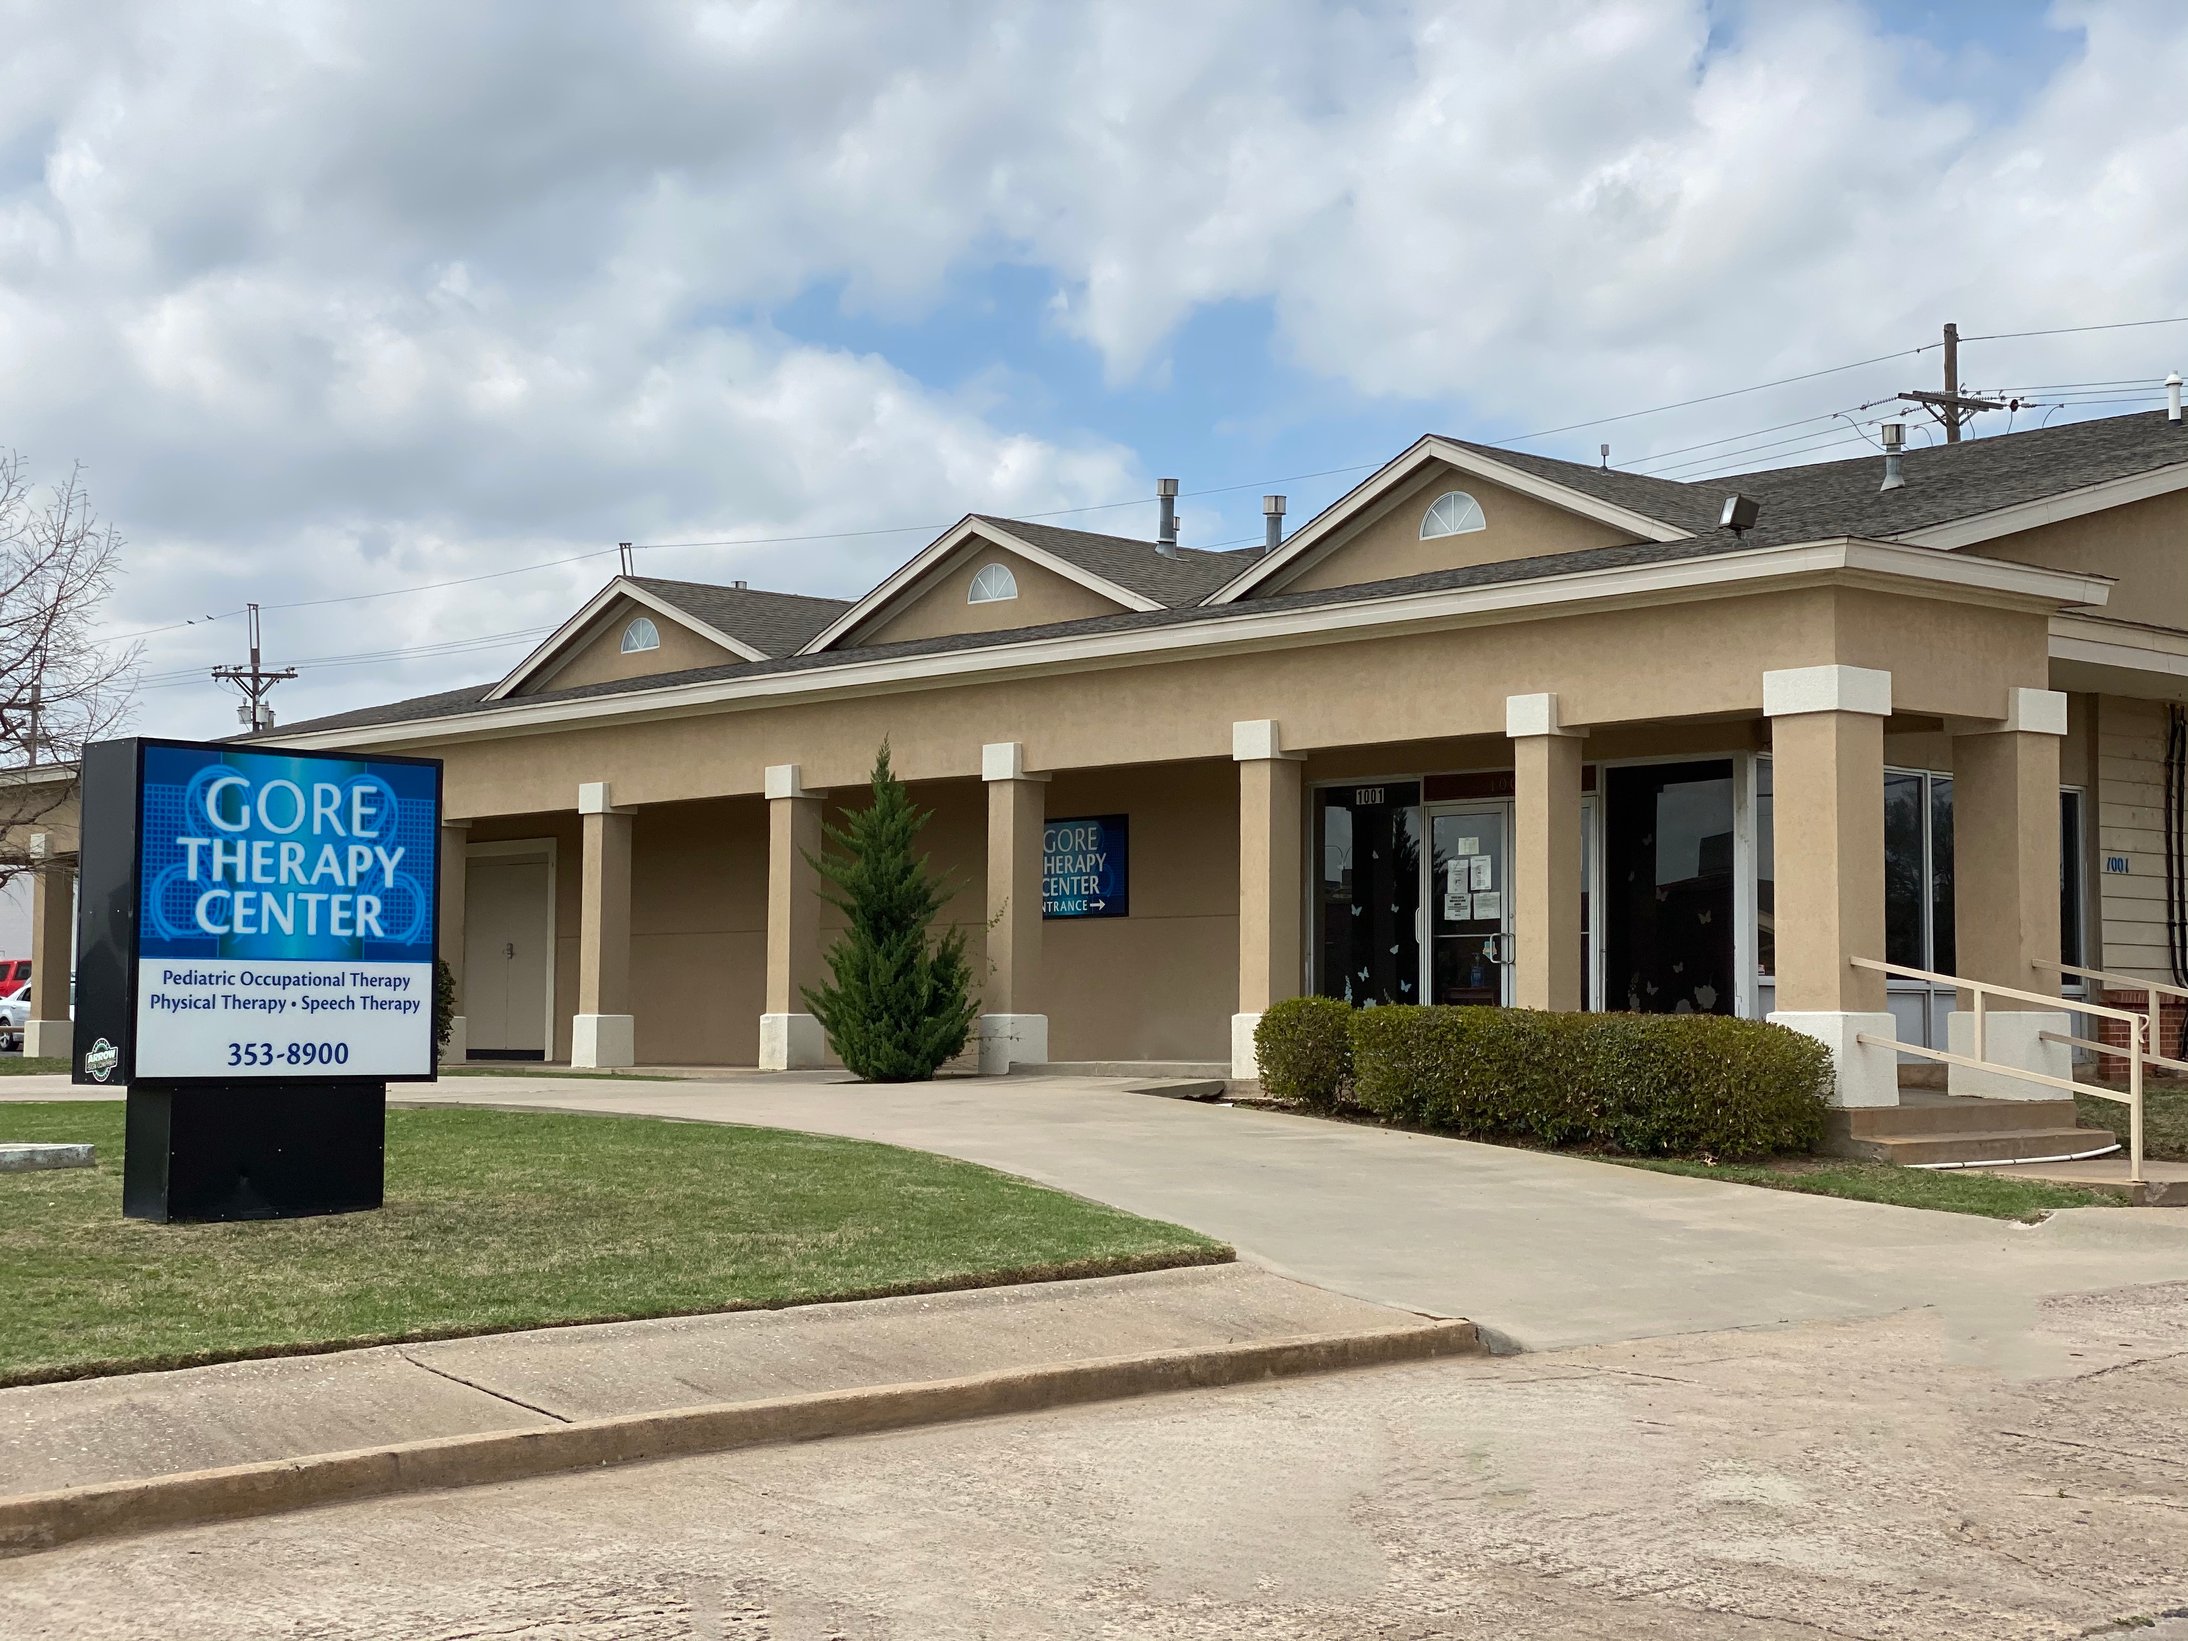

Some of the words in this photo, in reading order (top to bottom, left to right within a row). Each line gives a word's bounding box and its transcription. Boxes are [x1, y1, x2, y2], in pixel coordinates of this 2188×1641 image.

[206, 776, 379, 838] GORE
[1357, 788, 1383, 804] 1001
[1043, 827, 1098, 854] GORE
[176, 836, 405, 888] THERAPY
[1043, 853, 1107, 875] HERAPY
[2106, 856, 2129, 874] 1001
[1042, 875, 1100, 897] CENTER
[195, 889, 385, 937] CENTER
[1042, 900, 1088, 913] NTRANCE
[163, 970, 236, 986] Pediatric
[240, 971, 345, 990] Occupational
[350, 972, 411, 991] Therapy
[150, 994, 216, 1013] Physical
[221, 994, 287, 1013] Therapy
[301, 995, 355, 1014] Speech
[360, 996, 421, 1014] Therapy
[87, 1049, 116, 1064] ARROW
[227, 1042, 349, 1066] 353-8900
